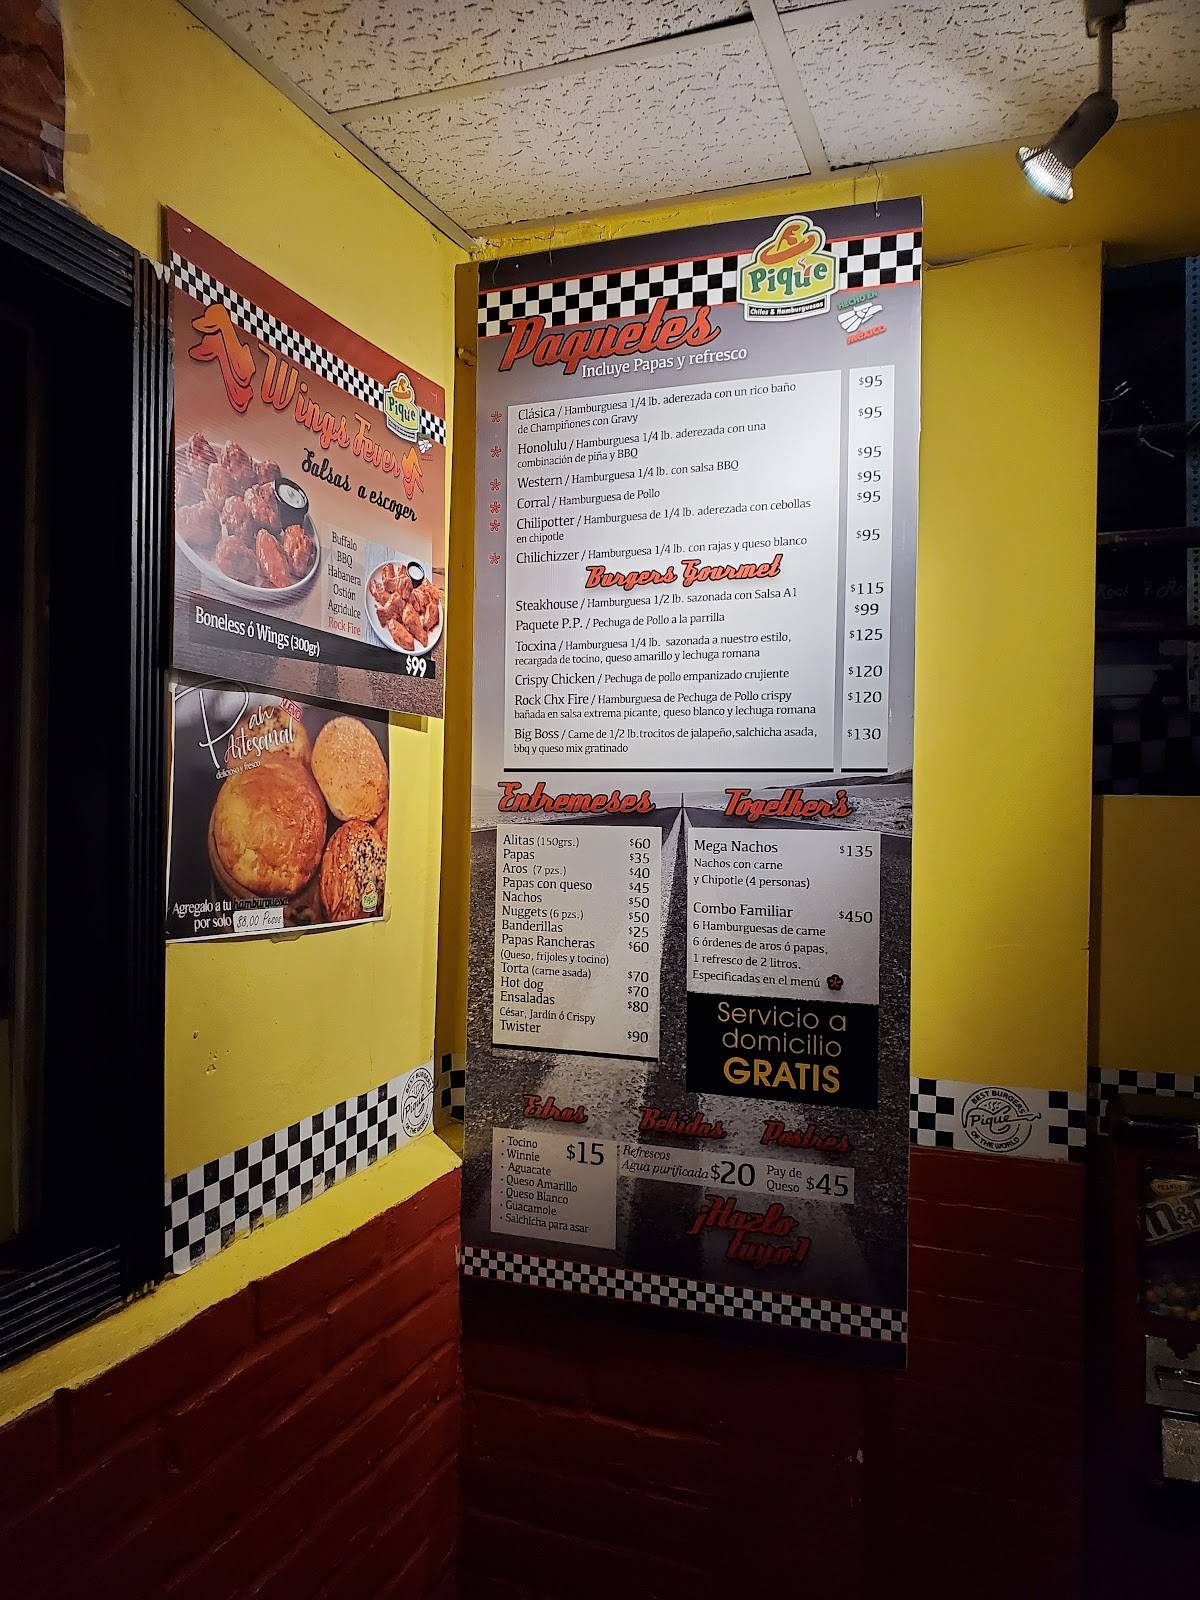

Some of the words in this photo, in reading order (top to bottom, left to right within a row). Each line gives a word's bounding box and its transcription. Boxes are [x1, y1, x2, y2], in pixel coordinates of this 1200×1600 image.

[749, 262, 827, 295] Pique
[770, 307, 775, 315] &
[777, 301, 823, 315] Hamburguesas
[499, 298, 721, 375] Paquetes
[582, 357, 630, 379] Incluye
[634, 356, 674, 373] Papas
[677, 357, 685, 370] y
[689, 346, 747, 366] refresco
[858, 375, 883, 388] $95
[388, 396, 416, 422] Pique
[518, 407, 555, 420] Clásica
[564, 402, 627, 415] Hamburguesa
[631, 398, 646, 408] 1/4
[648, 396, 660, 406] lb.
[663, 389, 712, 404] aderezada
[714, 390, 731, 398] con
[735, 388, 746, 396] un
[750, 386, 768, 395] rico
[771, 382, 796, 393] baño
[259, 341, 351, 449] Wings
[349, 413, 401, 479] Fever
[858, 406, 882, 419] $95
[518, 425, 528, 434] de
[530, 416, 590, 433] Champiñones
[593, 417, 609, 425] con
[611, 414, 638, 425] Gravy
[517, 454, 572, 468] combinación
[575, 453, 585, 462] de
[588, 451, 607, 463] piña
[609, 452, 615, 461] y
[618, 448, 638, 459] BBQ
[857, 446, 881, 458] $95
[302, 447, 352, 492] Salsas
[358, 486, 367, 498] a
[370, 492, 418, 522] escoger
[857, 470, 881, 483] $95
[517, 496, 550, 509] Corral
[559, 493, 621, 507] Hamburguesa
[624, 490, 634, 500] de
[637, 489, 660, 499] Pollo
[857, 491, 881, 503] $95
[332, 531, 358, 551] Buffalo
[856, 529, 880, 541] $95
[337, 549, 353, 568] BBQ
[328, 565, 362, 587] Habanera
[585, 565, 678, 591] Burgers
[681, 554, 783, 587] Gourmet
[333, 583, 356, 601] Ostión
[851, 582, 884, 595] $115
[515, 599, 578, 612] Steakhouse
[587, 596, 650, 610] Hamburguesa
[654, 594, 669, 605] 1/2
[672, 593, 684, 603] lb.
[687, 591, 732, 602] sazonada
[735, 592, 752, 600] con
[755, 589, 781, 599] Salsa
[783, 588, 797, 597] A1
[328, 598, 362, 620] Agridulce
[854, 603, 879, 616] $99
[195, 606, 246, 637] Boneless
[247, 623, 255, 638] ó
[257, 622, 290, 649] Wings
[290, 636, 320, 657] (300gr)
[328, 615, 345, 631] Rock
[347, 620, 361, 636] Fire
[849, 628, 883, 641] $125
[515, 655, 557, 667] recargada
[559, 655, 570, 664] de
[572, 655, 603, 664] tocino,
[606, 655, 631, 664] queso
[634, 651, 672, 661] amarillo
[675, 652, 680, 661] y
[682, 649, 719, 661] lechuga
[722, 649, 760, 659] romana
[406, 655, 427, 678] $99
[848, 665, 882, 678] $120
[848, 691, 881, 703] $120
[223, 719, 296, 763] Artesanal
[847, 728, 881, 740] $130
[244, 760, 261, 771] fresco
[498, 782, 656, 814] Entremeses
[724, 788, 853, 821] Together's
[503, 835, 534, 846] Alitas
[537, 836, 580, 848] (150grs.)
[630, 838, 650, 849] $60
[694, 840, 728, 856] Mega
[731, 840, 778, 853] Nachos
[503, 849, 535, 862] Papas
[630, 853, 649, 864] $35
[839, 845, 873, 858] $135
[503, 877, 534, 890] Papas
[537, 881, 557, 889] con
[560, 880, 592, 892] queso
[629, 883, 649, 893] $45
[502, 891, 542, 903] Nachos
[629, 897, 649, 908] $50
[172, 899, 213, 918] Agregalo
[215, 903, 220, 912] a
[223, 900, 232, 911] tu
[502, 905, 547, 920] Nuggets
[550, 908, 559, 920] (6
[562, 909, 584, 920] pzs.)
[693, 902, 736, 916] Combo
[740, 904, 794, 918] Familiar
[194, 917, 211, 932] por
[213, 913, 232, 927] solo
[629, 912, 649, 923] $50
[838, 910, 873, 924] $450
[502, 920, 563, 933] Banderillas
[629, 927, 649, 938] $25
[693, 921, 699, 930] 6
[702, 920, 778, 936] Hamburguesas
[780, 924, 794, 935] de
[796, 926, 825, 937] carne
[501, 977, 521, 988] Hot
[524, 978, 544, 992] dog
[628, 986, 649, 997] $70
[500, 991, 555, 1005] Ensaladas
[628, 1001, 649, 1012] $80
[718, 1001, 819, 1029] Servicio
[829, 1014, 846, 1031] a
[500, 1020, 541, 1033] Twister
[627, 1031, 648, 1043] $90
[722, 1029, 841, 1057] domicilio
[723, 1056, 840, 1093] GRATIS
[971, 1091, 989, 1104] BEST
[992, 1091, 1026, 1113] BURGERS
[640, 1108, 727, 1139] Bebidas
[969, 1115, 1009, 1128] Pique
[508, 1136, 538, 1149] Tocino
[971, 1131, 980, 1139] OF
[980, 1138, 994, 1148] THE
[995, 1136, 1020, 1149] WORLD
[507, 1149, 540, 1162] Winnie
[566, 1141, 604, 1166] $15
[623, 1145, 671, 1161] Refrescos
[509, 1162, 552, 1178] Aguacate
[622, 1159, 649, 1175] Agua
[651, 1162, 708, 1180] purificada
[711, 1160, 756, 1187] $20
[806, 1173, 849, 1197] $45
[506, 1200, 557, 1216] Guacamole
